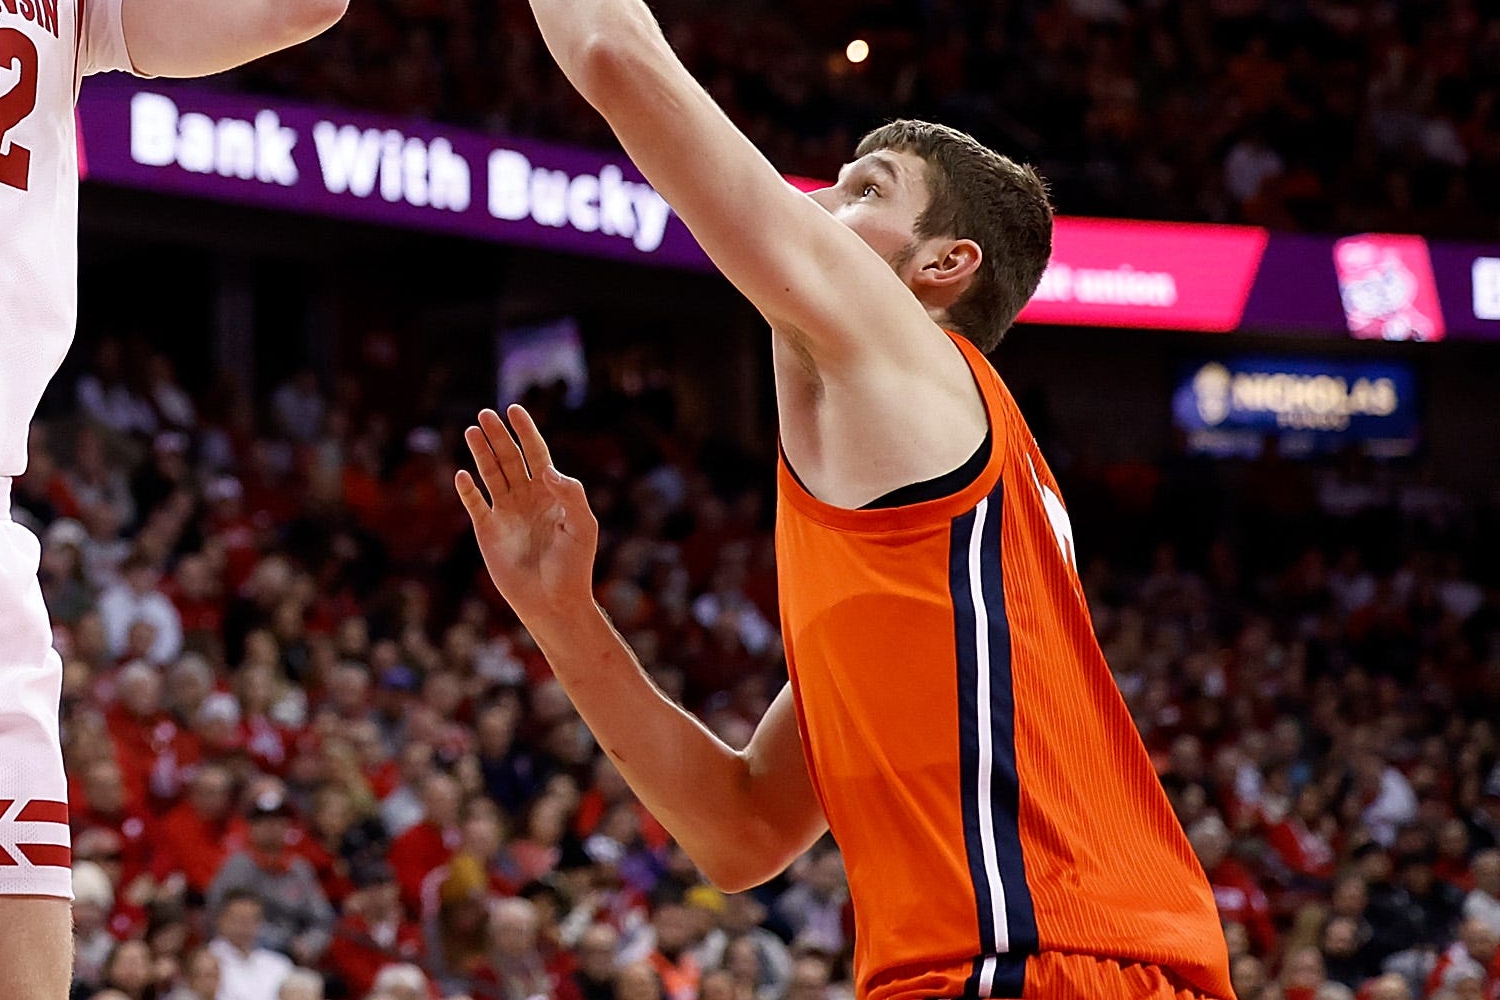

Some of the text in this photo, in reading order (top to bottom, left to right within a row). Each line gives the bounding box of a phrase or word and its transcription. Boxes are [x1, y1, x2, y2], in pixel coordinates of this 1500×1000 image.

[130, 91, 671, 253] Bank With Bucky
